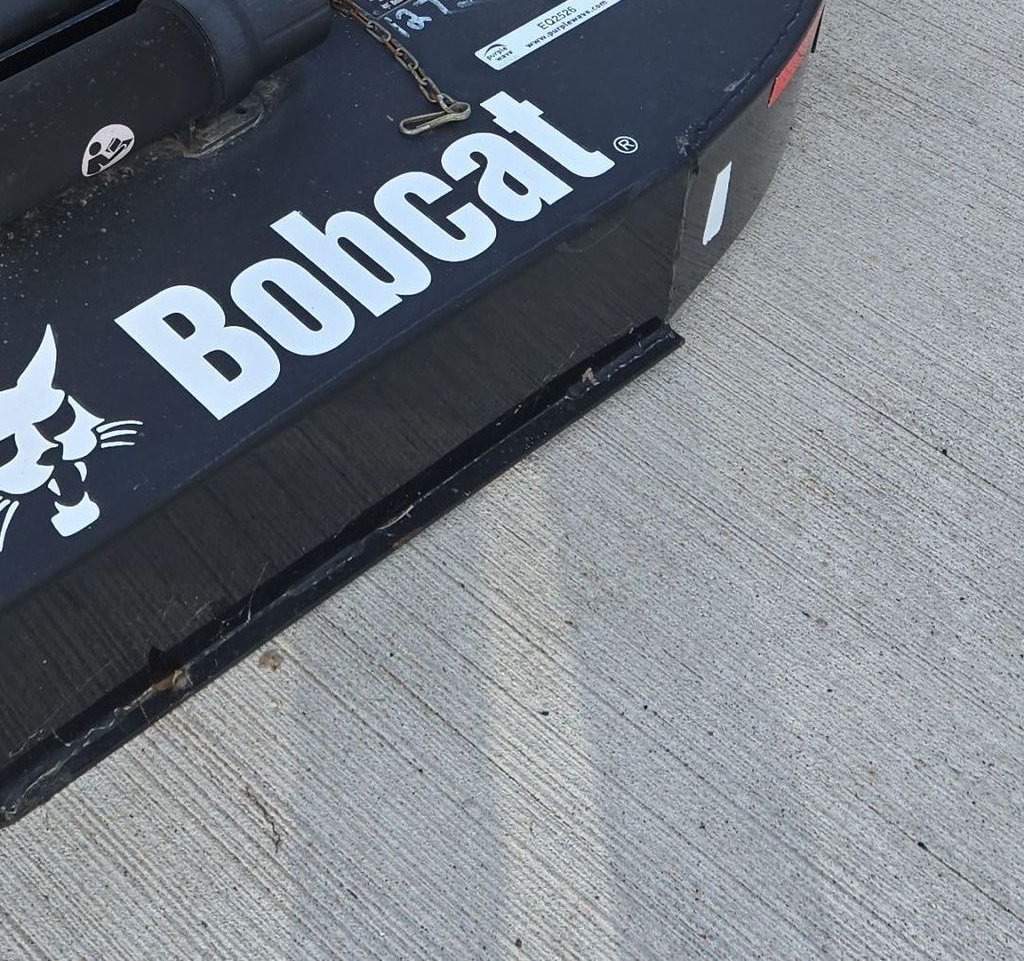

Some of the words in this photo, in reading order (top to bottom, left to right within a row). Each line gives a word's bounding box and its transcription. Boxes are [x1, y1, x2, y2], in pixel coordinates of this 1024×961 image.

[523, 0, 609, 48] www.purplewave.com
[536, 5, 578, 29] EQ2526
[484, 46, 509, 60] purple
[495, 50, 514, 61] wave
[115, 91, 615, 421] Bobcat
